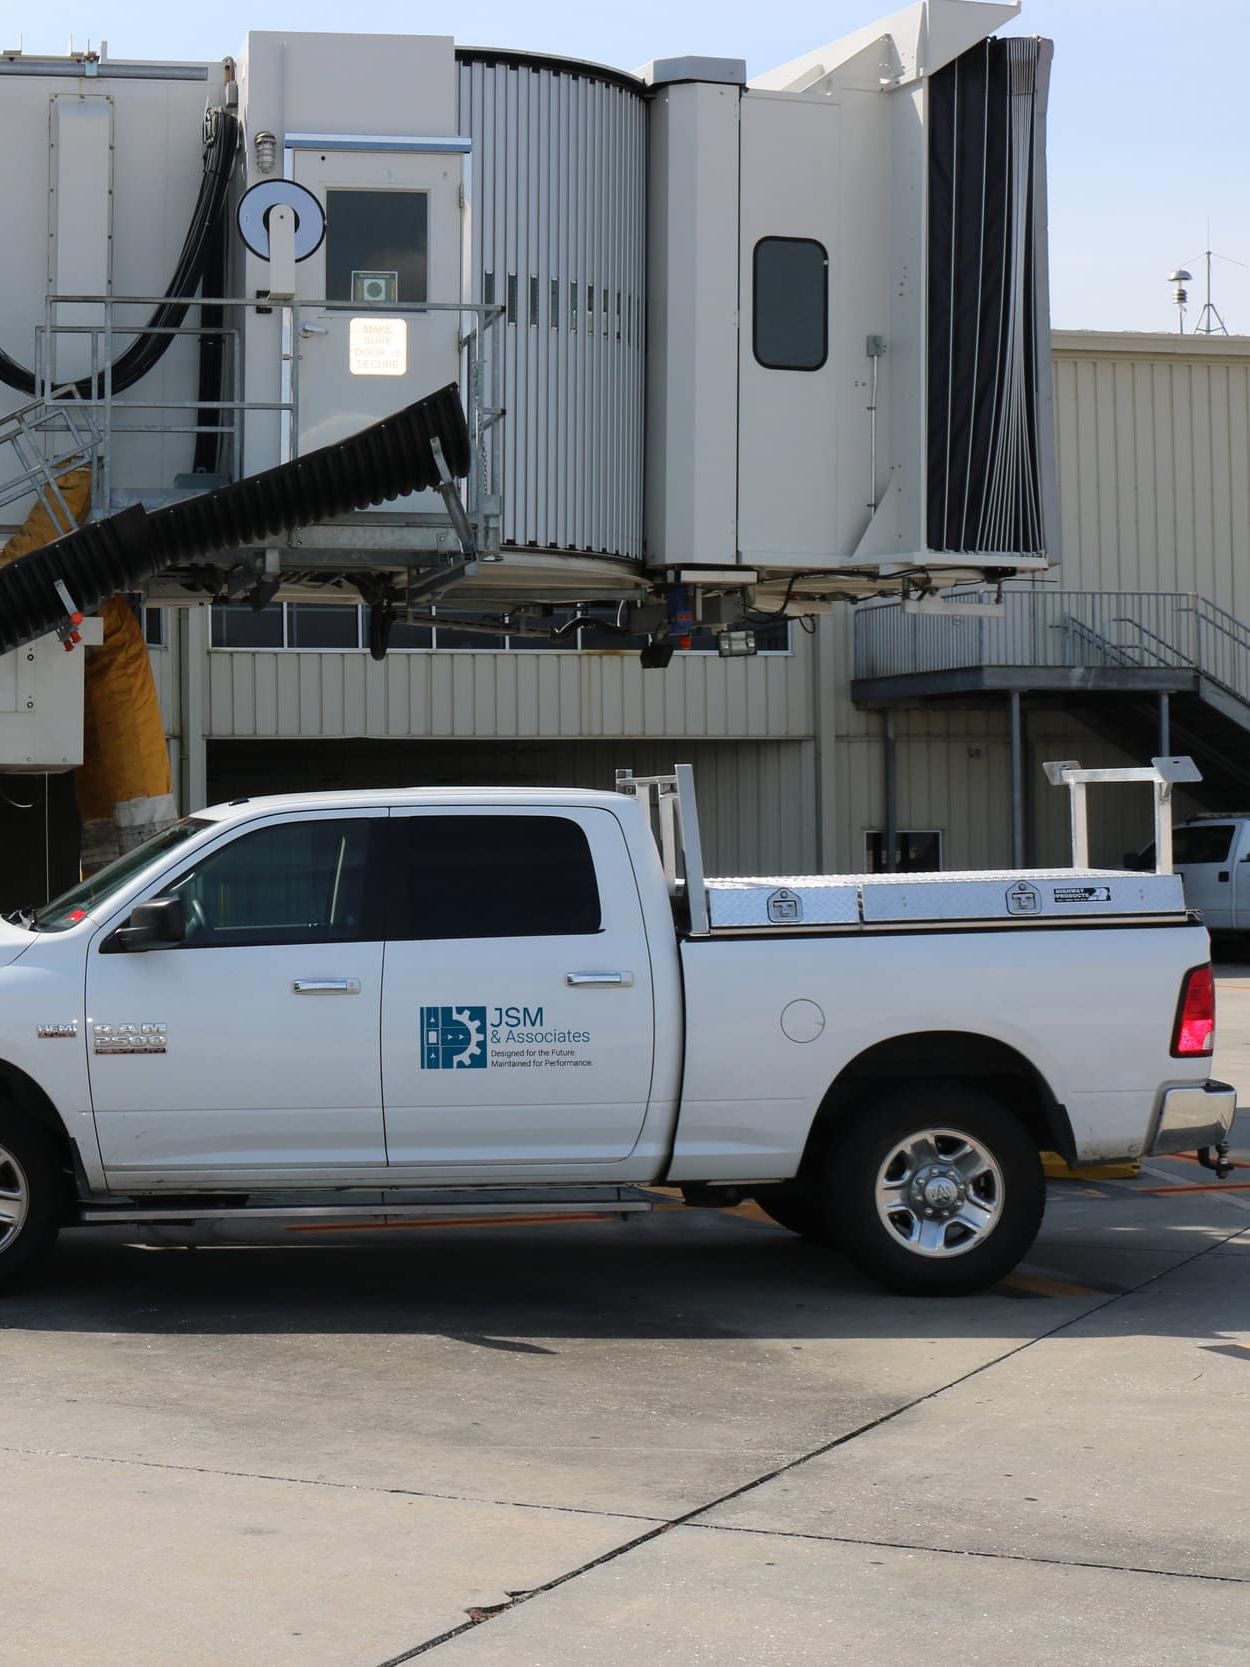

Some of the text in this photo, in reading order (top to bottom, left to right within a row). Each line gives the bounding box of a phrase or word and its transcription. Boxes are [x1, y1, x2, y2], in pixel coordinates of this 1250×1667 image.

[363, 324, 394, 334] MAKE
[363, 336, 391, 345] SURE
[356, 359, 400, 369] SECURE
[490, 1007, 544, 1028] JSM
[37, 1023, 78, 1032] HEMI
[93, 1023, 167, 1034] RAM
[93, 1034, 167, 1047] 2500
[490, 1029, 590, 1044] & Associates
[490, 1049, 575, 1059] Designed for the Future
[490, 1060, 532, 1068] Maintained
[532, 1060, 543, 1068] for
